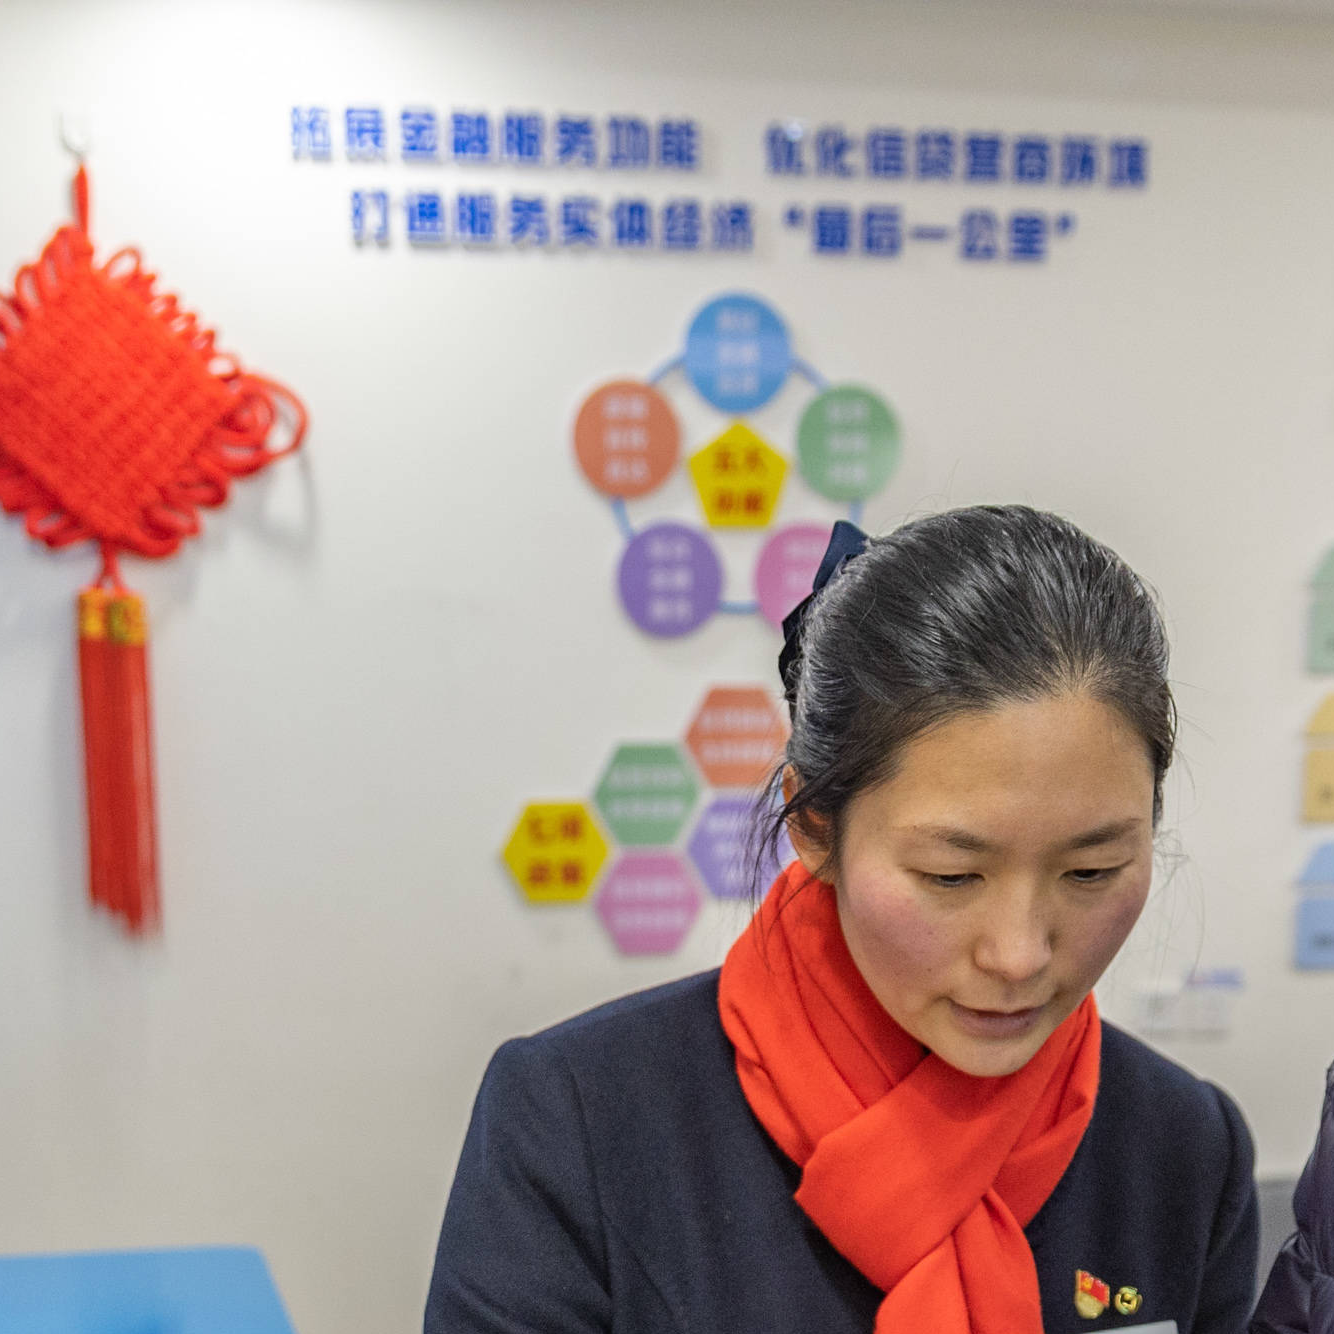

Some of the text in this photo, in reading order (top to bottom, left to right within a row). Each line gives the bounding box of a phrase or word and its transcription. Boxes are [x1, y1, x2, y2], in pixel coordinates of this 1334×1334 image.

[290, 104, 698, 170] 拓展金融服务功能
